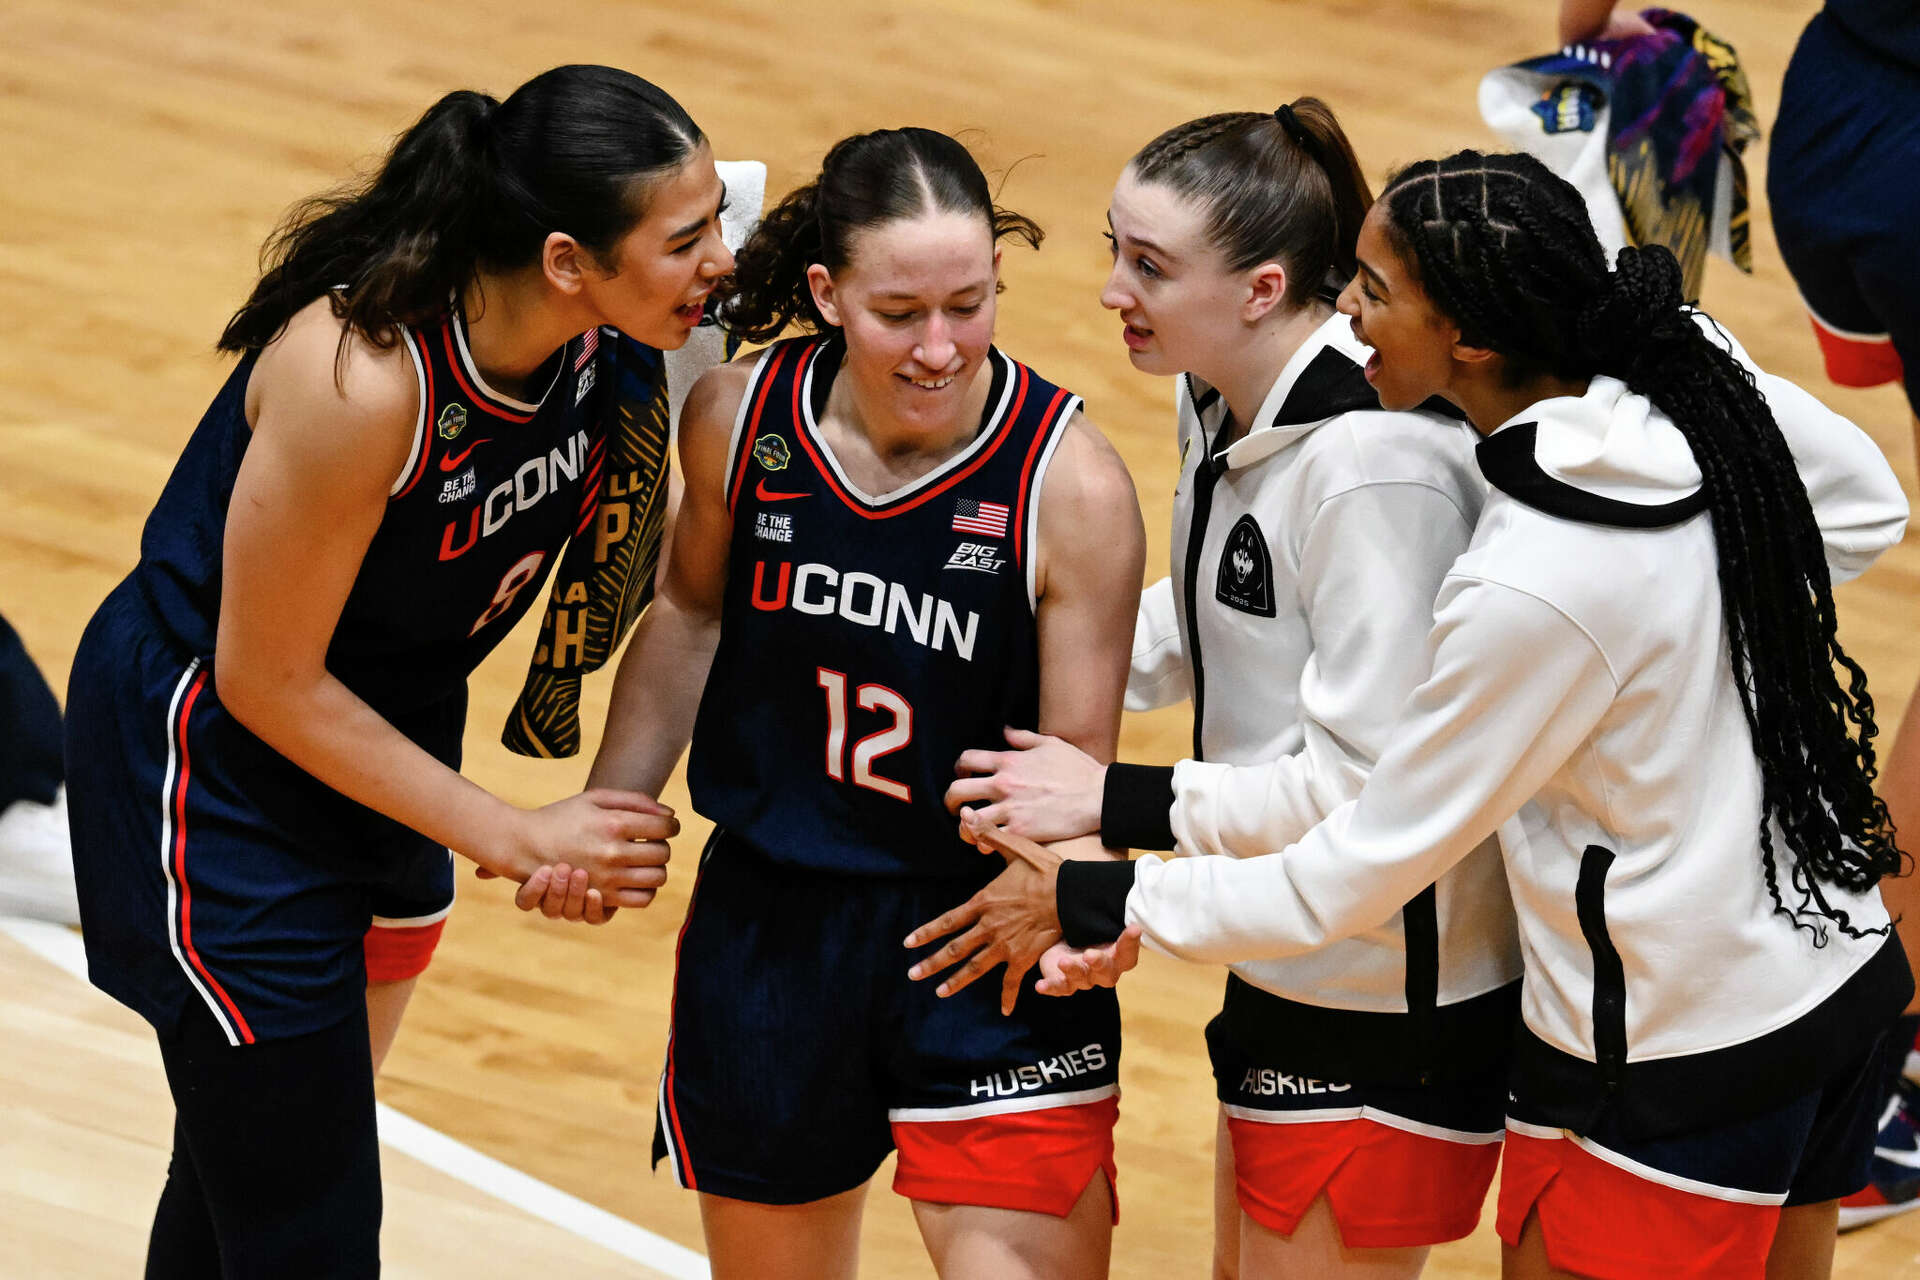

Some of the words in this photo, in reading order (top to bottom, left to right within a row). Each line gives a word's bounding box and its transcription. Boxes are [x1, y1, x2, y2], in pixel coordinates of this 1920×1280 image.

[443, 479, 460, 493] BE
[462, 466, 475, 486] TH
[599, 470, 645, 497] LL
[439, 481, 476, 503] CHANG
[755, 524, 793, 543] CHANGE
[757, 513, 768, 526] BE
[769, 515, 791, 530] THE
[947, 553, 1006, 570] EAST
[956, 543, 998, 557] BIG
[751, 561, 980, 662] UCONN
[817, 666, 913, 804] 12
[970, 1043, 1107, 1098] HUSKIES
